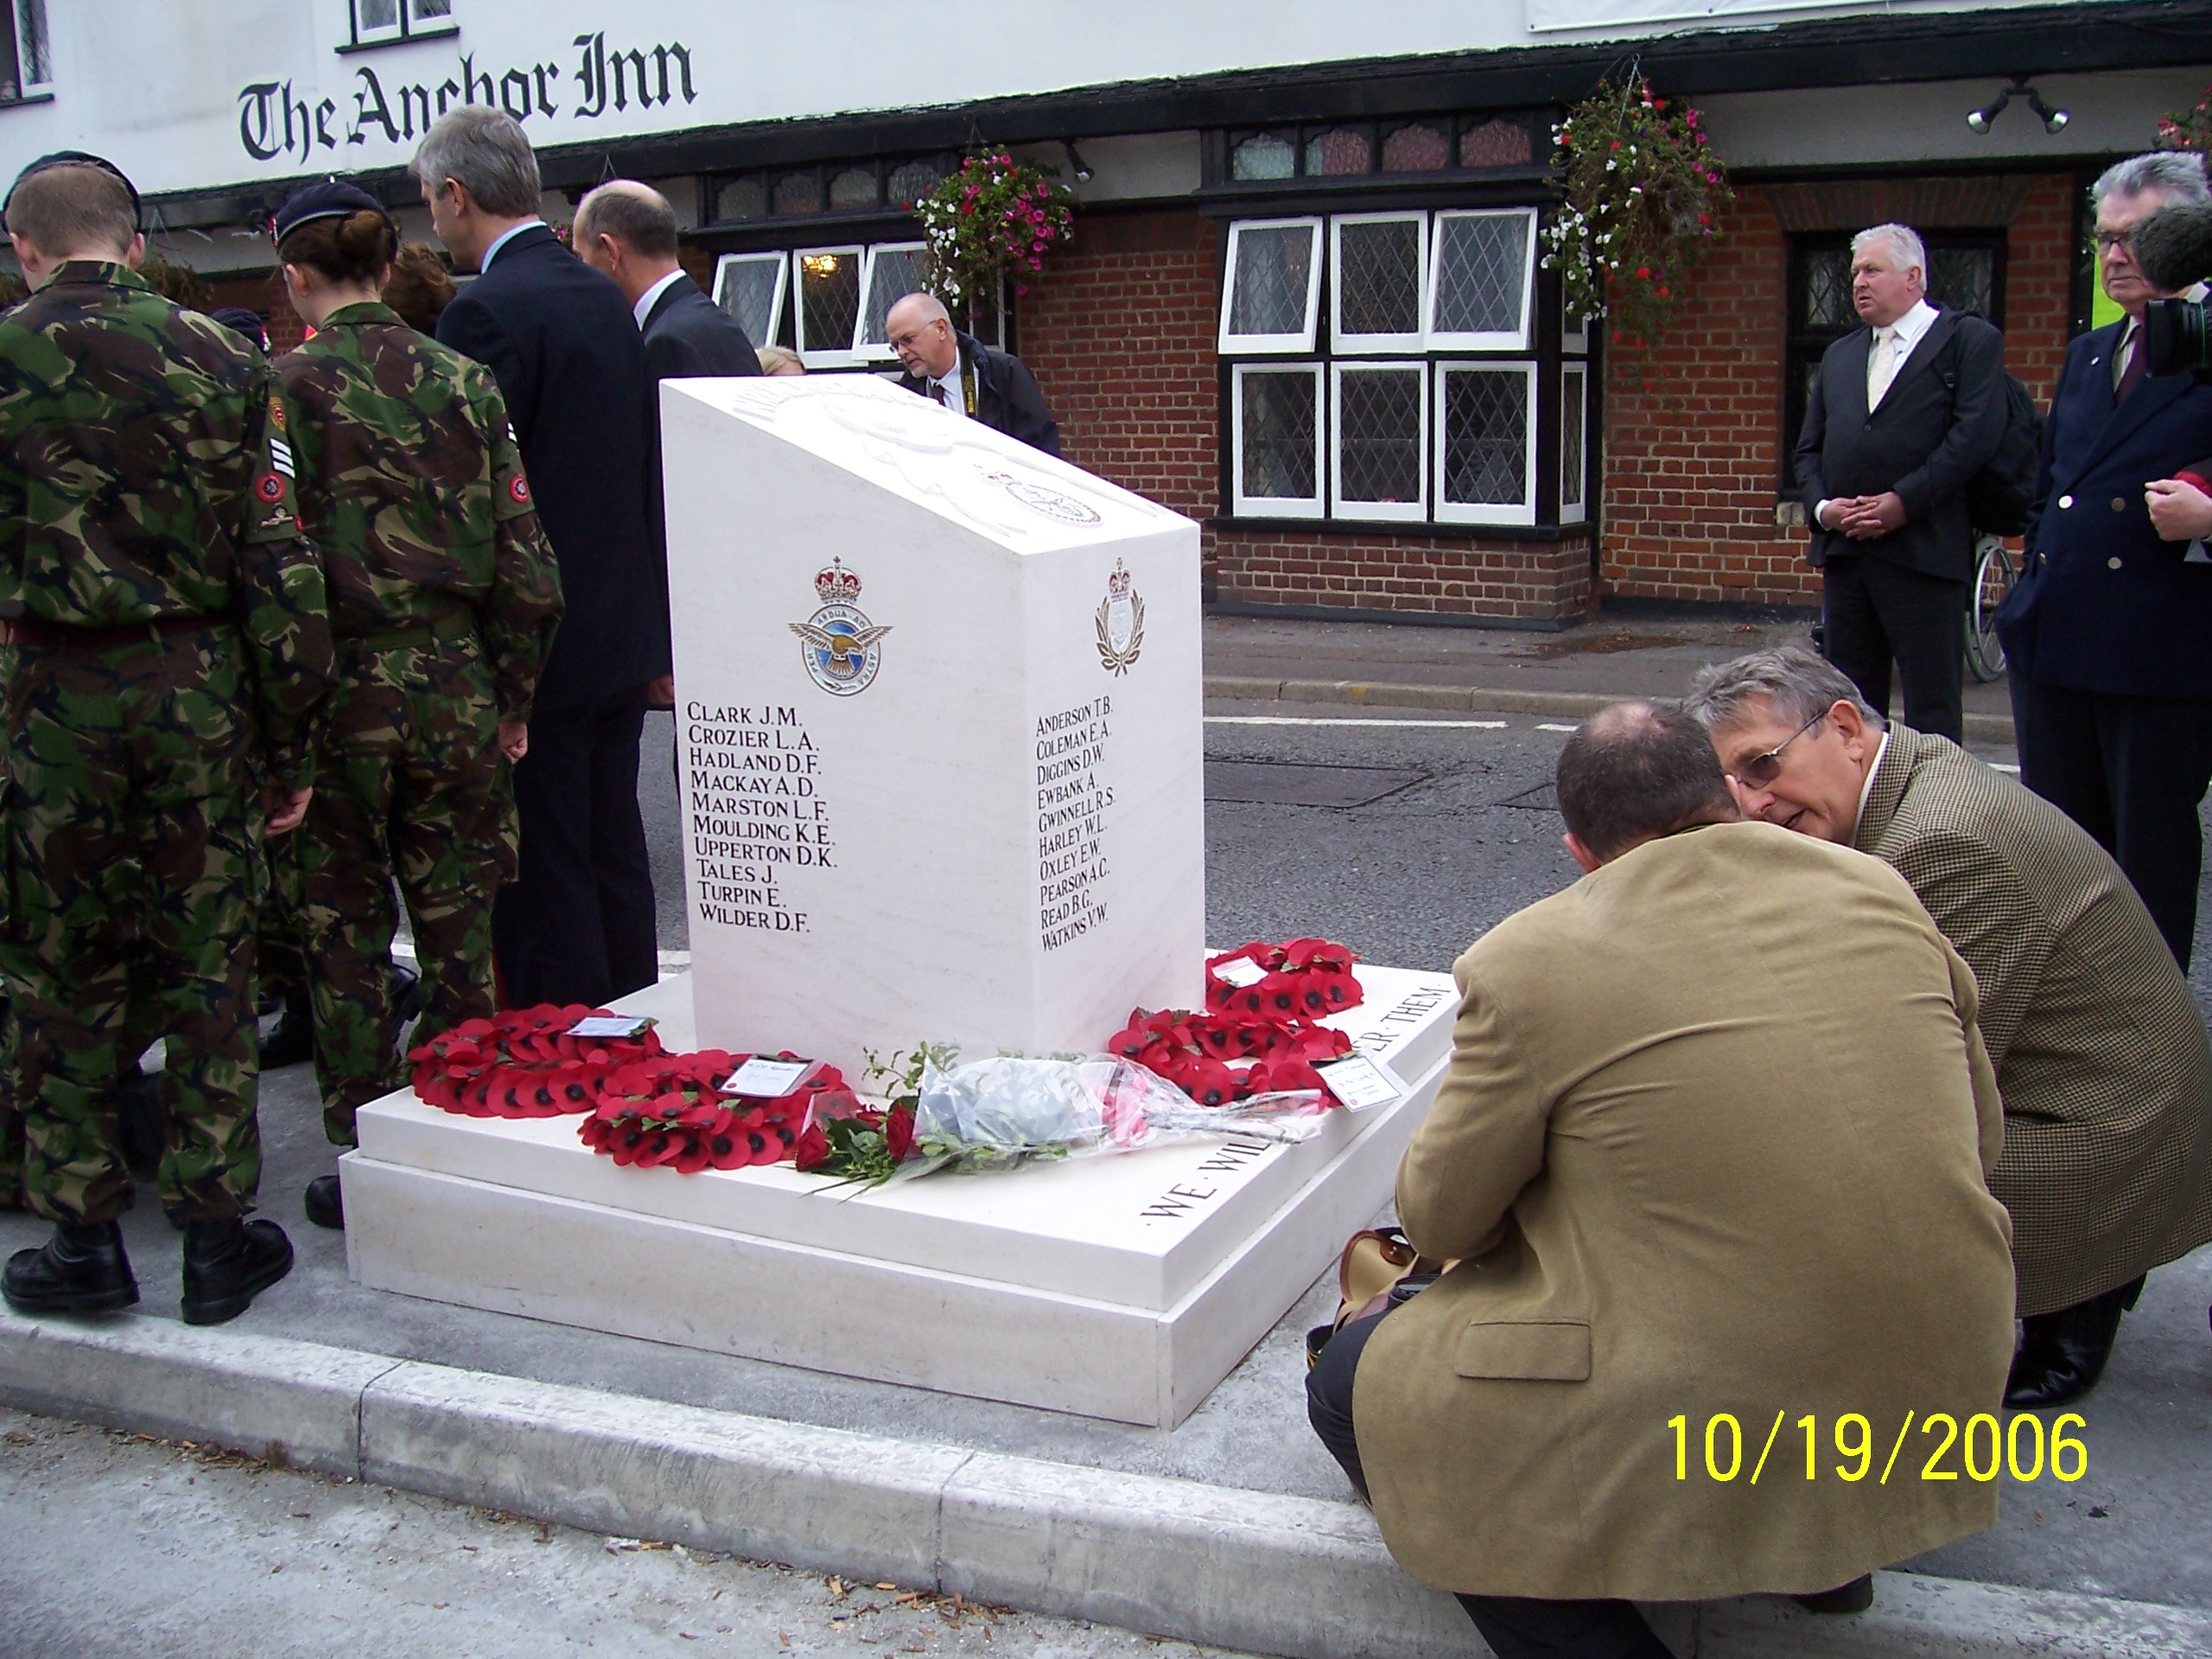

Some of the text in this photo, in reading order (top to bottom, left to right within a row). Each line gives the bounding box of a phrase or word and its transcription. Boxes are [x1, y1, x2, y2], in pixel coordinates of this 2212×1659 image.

[238, 30, 698, 166] The Anchor Inn
[688, 701, 753, 724] CLARK
[1036, 704, 1091, 737] ANDERSON
[688, 725, 769, 748] CROZIER
[1037, 728, 1087, 760] COLEMAN
[690, 747, 781, 772] HADLAND
[1037, 755, 1080, 785] DIGGINS
[691, 770, 772, 794] MACKAY
[1038, 778, 1084, 810] EWBANK
[692, 791, 788, 818] MARSTON
[1039, 798, 1094, 833] GWINNELL
[694, 815, 790, 842] MOULDING
[1039, 824, 1083, 858] HARLEY
[695, 836, 791, 864] UPPERTON
[696, 858, 755, 883] TALES
[1039, 850, 1077, 880] OXLEY
[697, 880, 762, 905] TURPIN
[1040, 869, 1087, 906] PEARSON
[700, 903, 772, 929] WILDER
[1040, 902, 1070, 930] READ
[1042, 917, 1086, 951] WATKINS
[1139, 1183, 1217, 1217] WE
[1197, 1142, 1272, 1171] WIL
